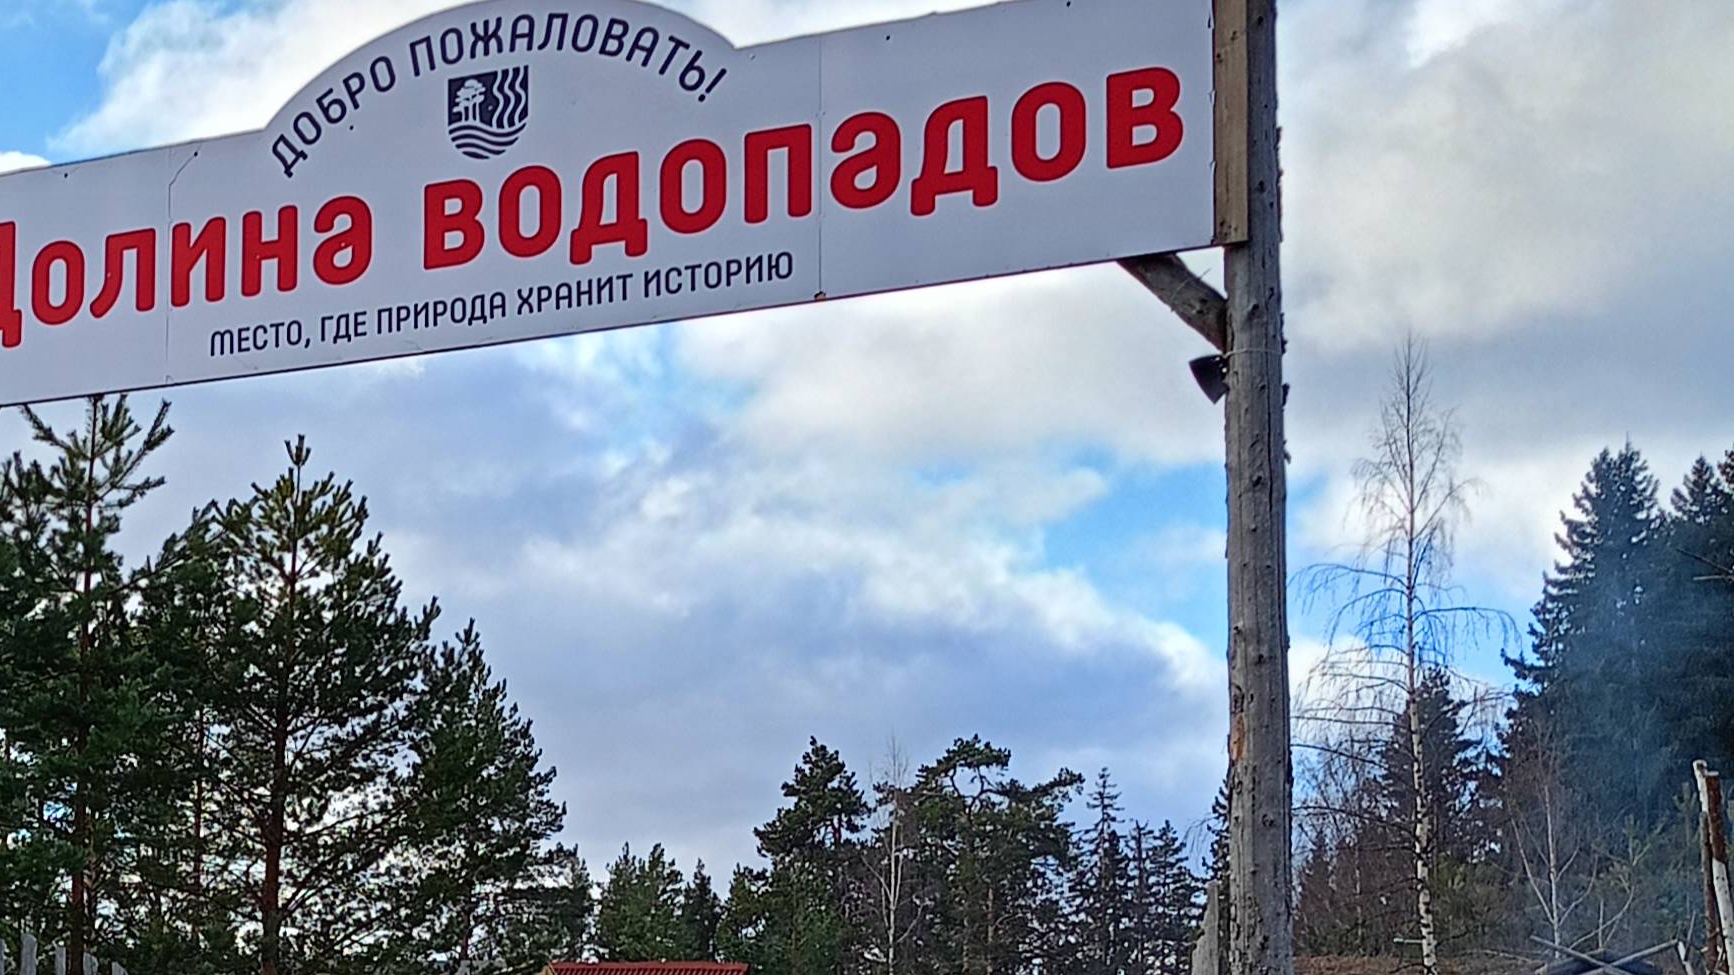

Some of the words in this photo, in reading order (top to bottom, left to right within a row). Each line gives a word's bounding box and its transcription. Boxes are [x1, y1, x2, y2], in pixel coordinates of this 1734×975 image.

[271, 55, 397, 178] ДОБРО
[409, 12, 727, 102] ПОЖАЛОВАТЬ!
[423, 66, 1184, 270] водопадов
[209, 319, 312, 357] МЕСТО,
[320, 310, 368, 344] ГДЕ
[376, 290, 507, 335] ПРИРОДА
[516, 273, 634, 316] ХРАНИТ
[643, 251, 794, 298] ИСТОРИЮ
